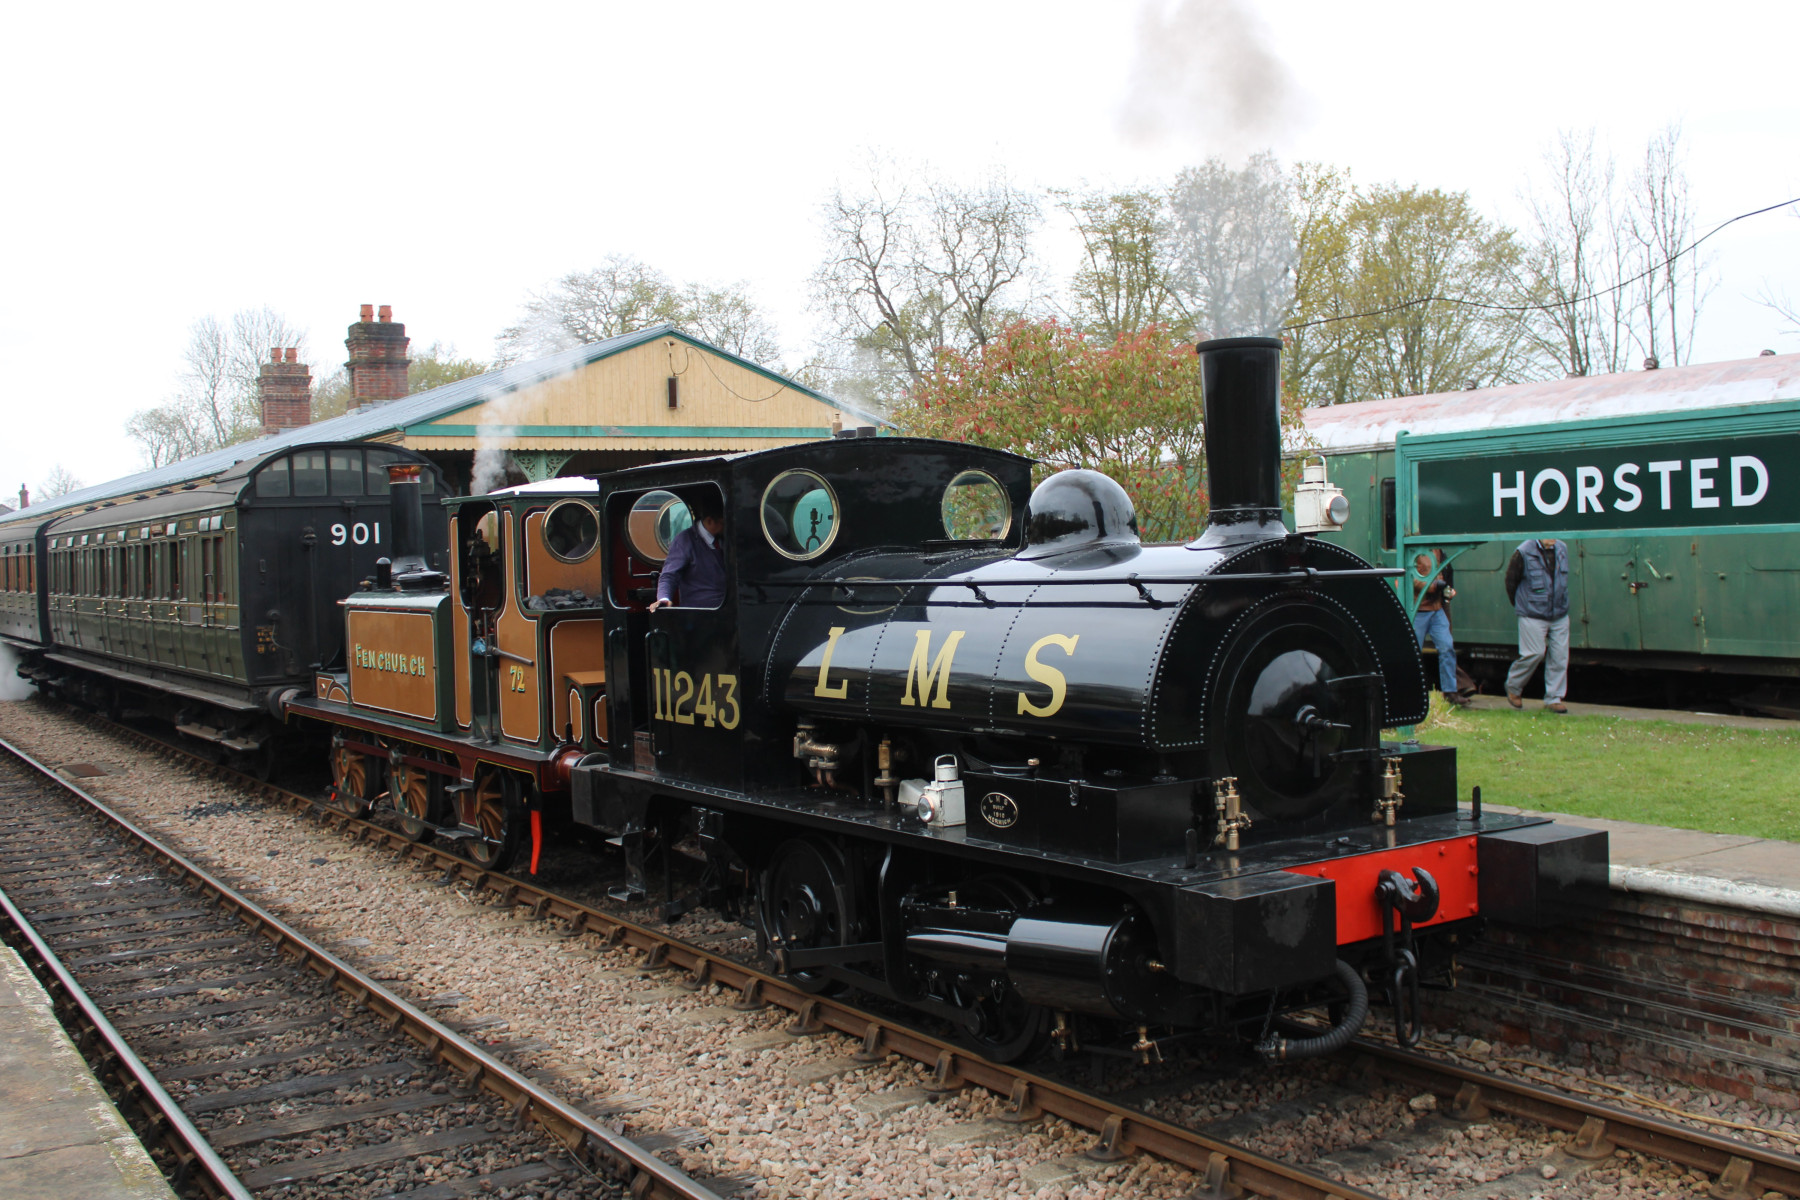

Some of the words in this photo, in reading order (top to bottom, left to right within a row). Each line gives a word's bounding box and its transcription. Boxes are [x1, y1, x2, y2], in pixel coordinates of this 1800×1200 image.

[1491, 455, 1770, 518] HORSTED
[330, 522, 381, 546] 901
[355, 642, 426, 677] FENCHURCH
[509, 665, 526, 693] 72
[652, 667, 741, 731] 11243
